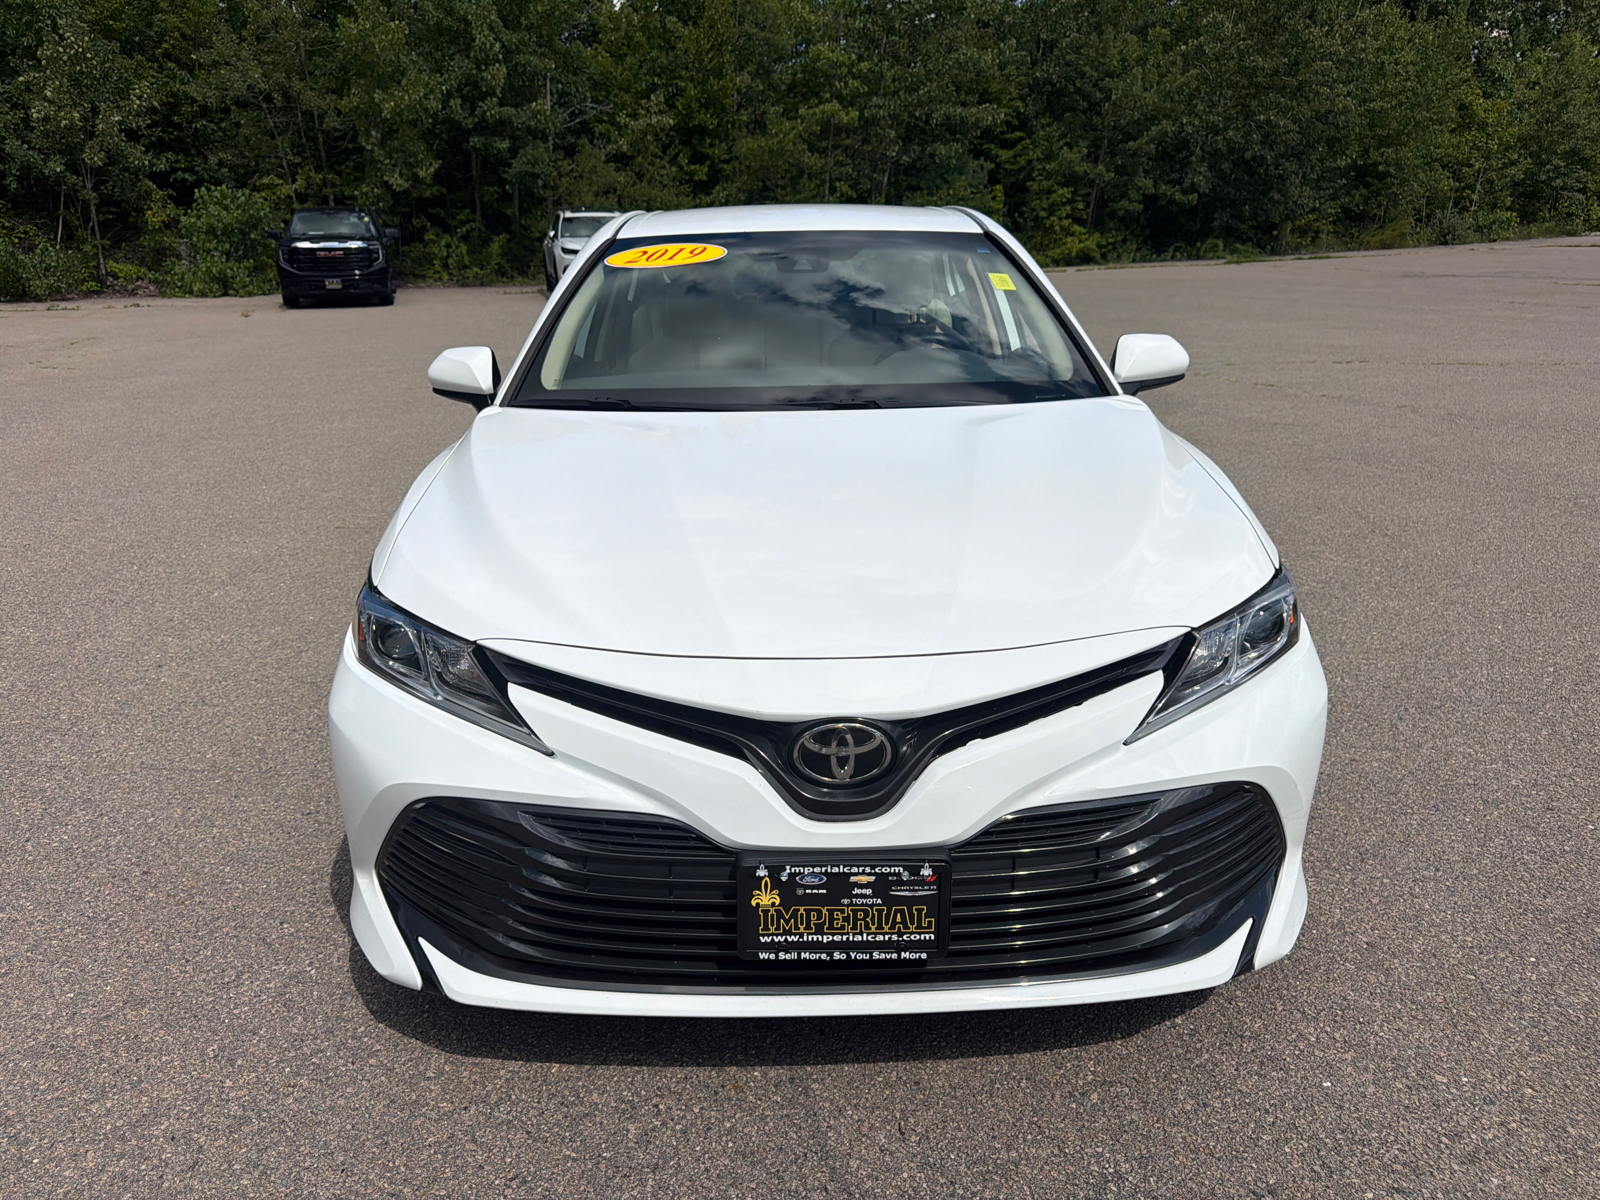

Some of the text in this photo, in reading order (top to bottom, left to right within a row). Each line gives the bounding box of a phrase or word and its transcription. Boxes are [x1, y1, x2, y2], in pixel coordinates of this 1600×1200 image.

[316, 250, 344, 258] GMC
[622, 246, 708, 264] 2019
[785, 865, 903, 874] Imperialcars.com
[851, 887, 873, 895] Jeep
[758, 906, 935, 933] IMPERIAL
[759, 932, 935, 943] www.imperialcars.com
[758, 951, 928, 961] We Sell More, So You Save More
